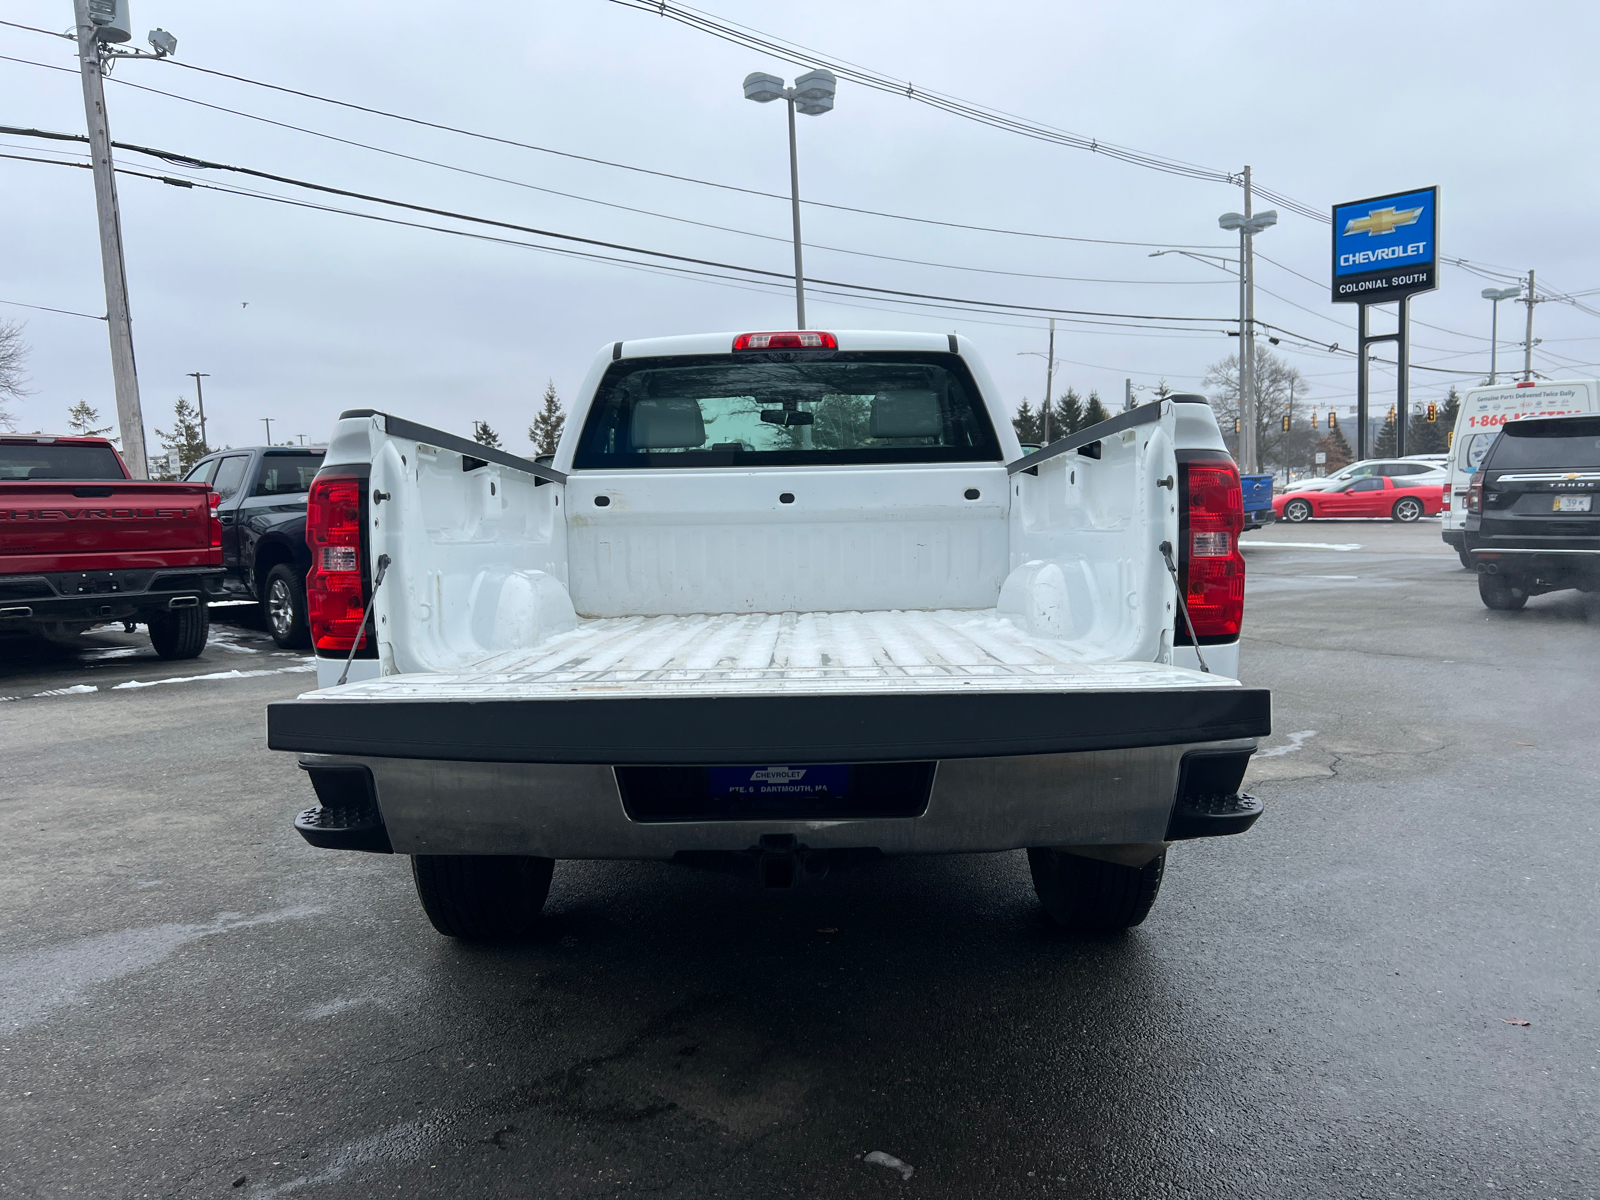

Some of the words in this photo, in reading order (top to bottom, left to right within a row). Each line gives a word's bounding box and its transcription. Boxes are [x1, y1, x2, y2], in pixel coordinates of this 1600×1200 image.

[1340, 241, 1427, 267] CHEVROLET
[1339, 278, 1389, 294] COLONIAL
[1392, 272, 1427, 286] SOUTH
[1515, 391, 1542, 399] Delivered
[1559, 389, 1576, 397] Daily
[755, 771, 801, 779] CHEVROLET
[760, 785, 813, 793] DARTMOUTH,
